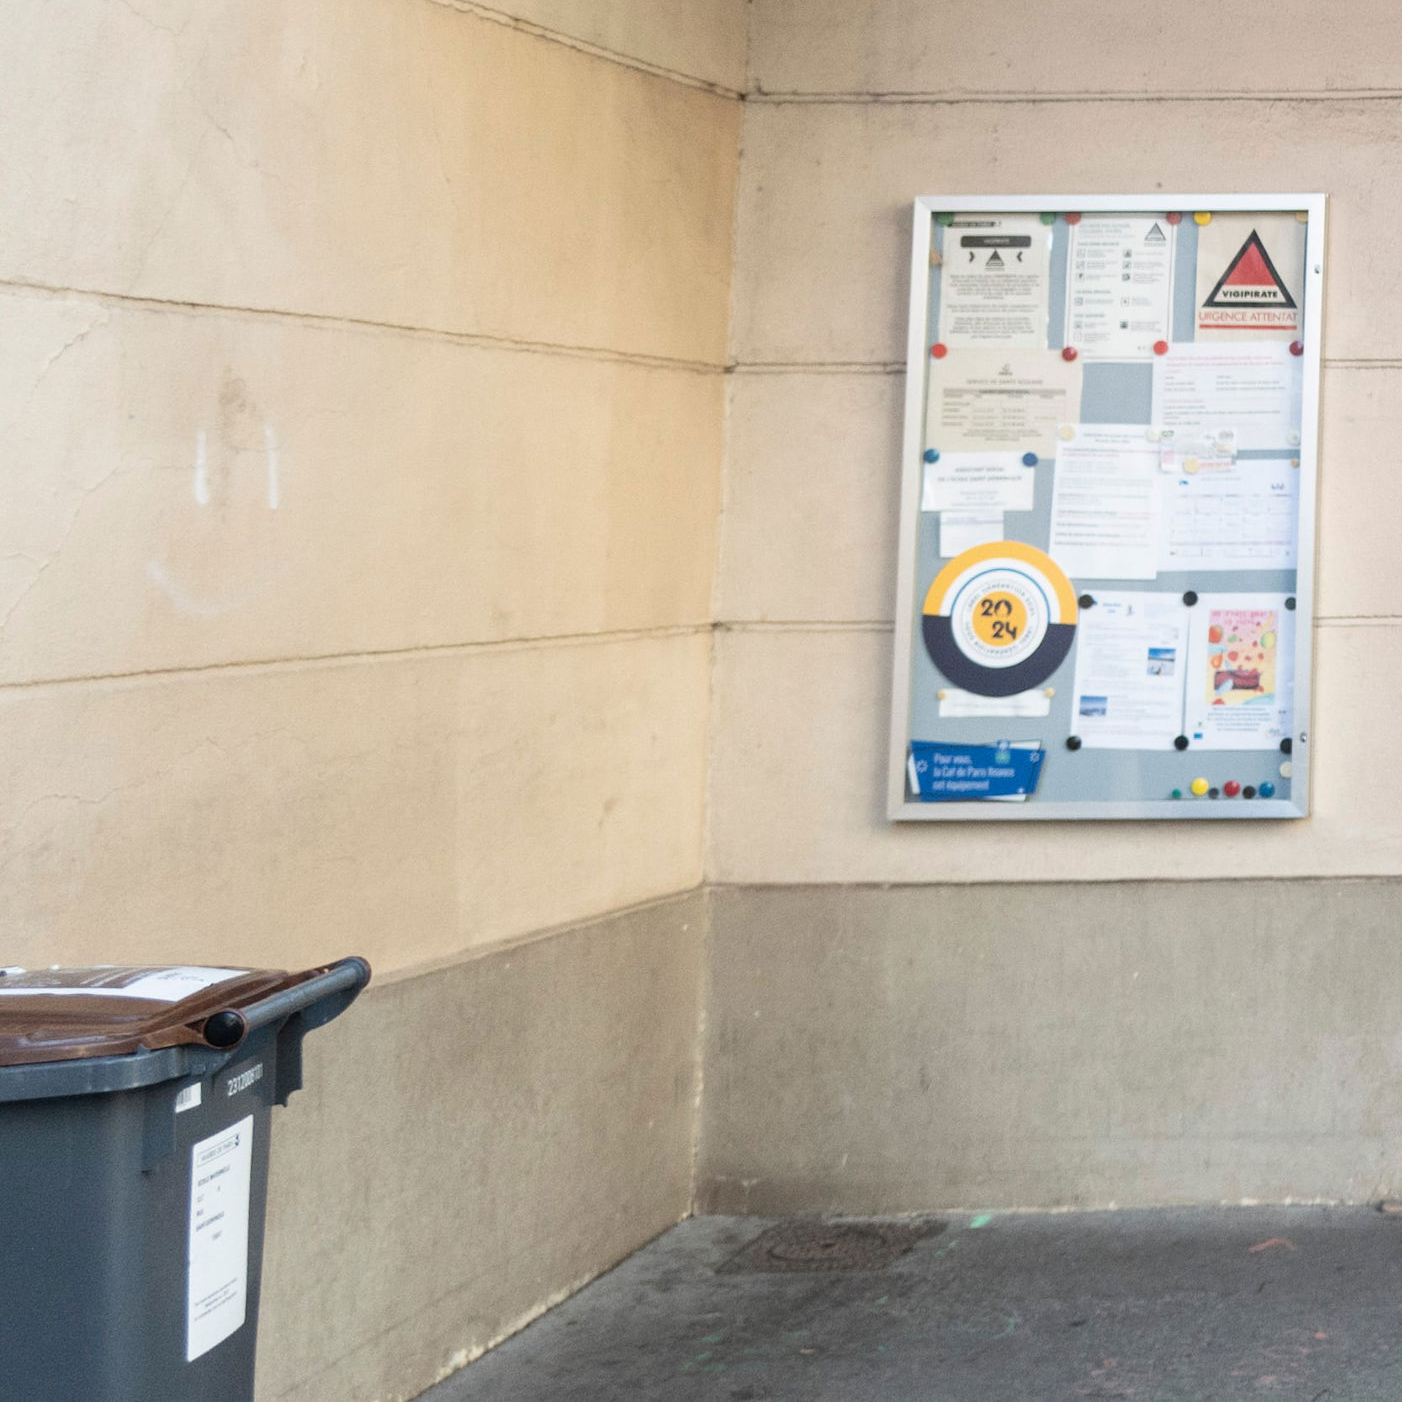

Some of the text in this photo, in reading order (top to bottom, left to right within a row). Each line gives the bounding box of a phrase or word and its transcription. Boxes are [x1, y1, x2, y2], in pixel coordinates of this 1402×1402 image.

[1221, 288, 1279, 300] VIGIPIRATE
[1198, 311, 1298, 323] URGENCE ATTENTAT
[980, 598, 1013, 617] 20
[992, 620, 1018, 640] 24
